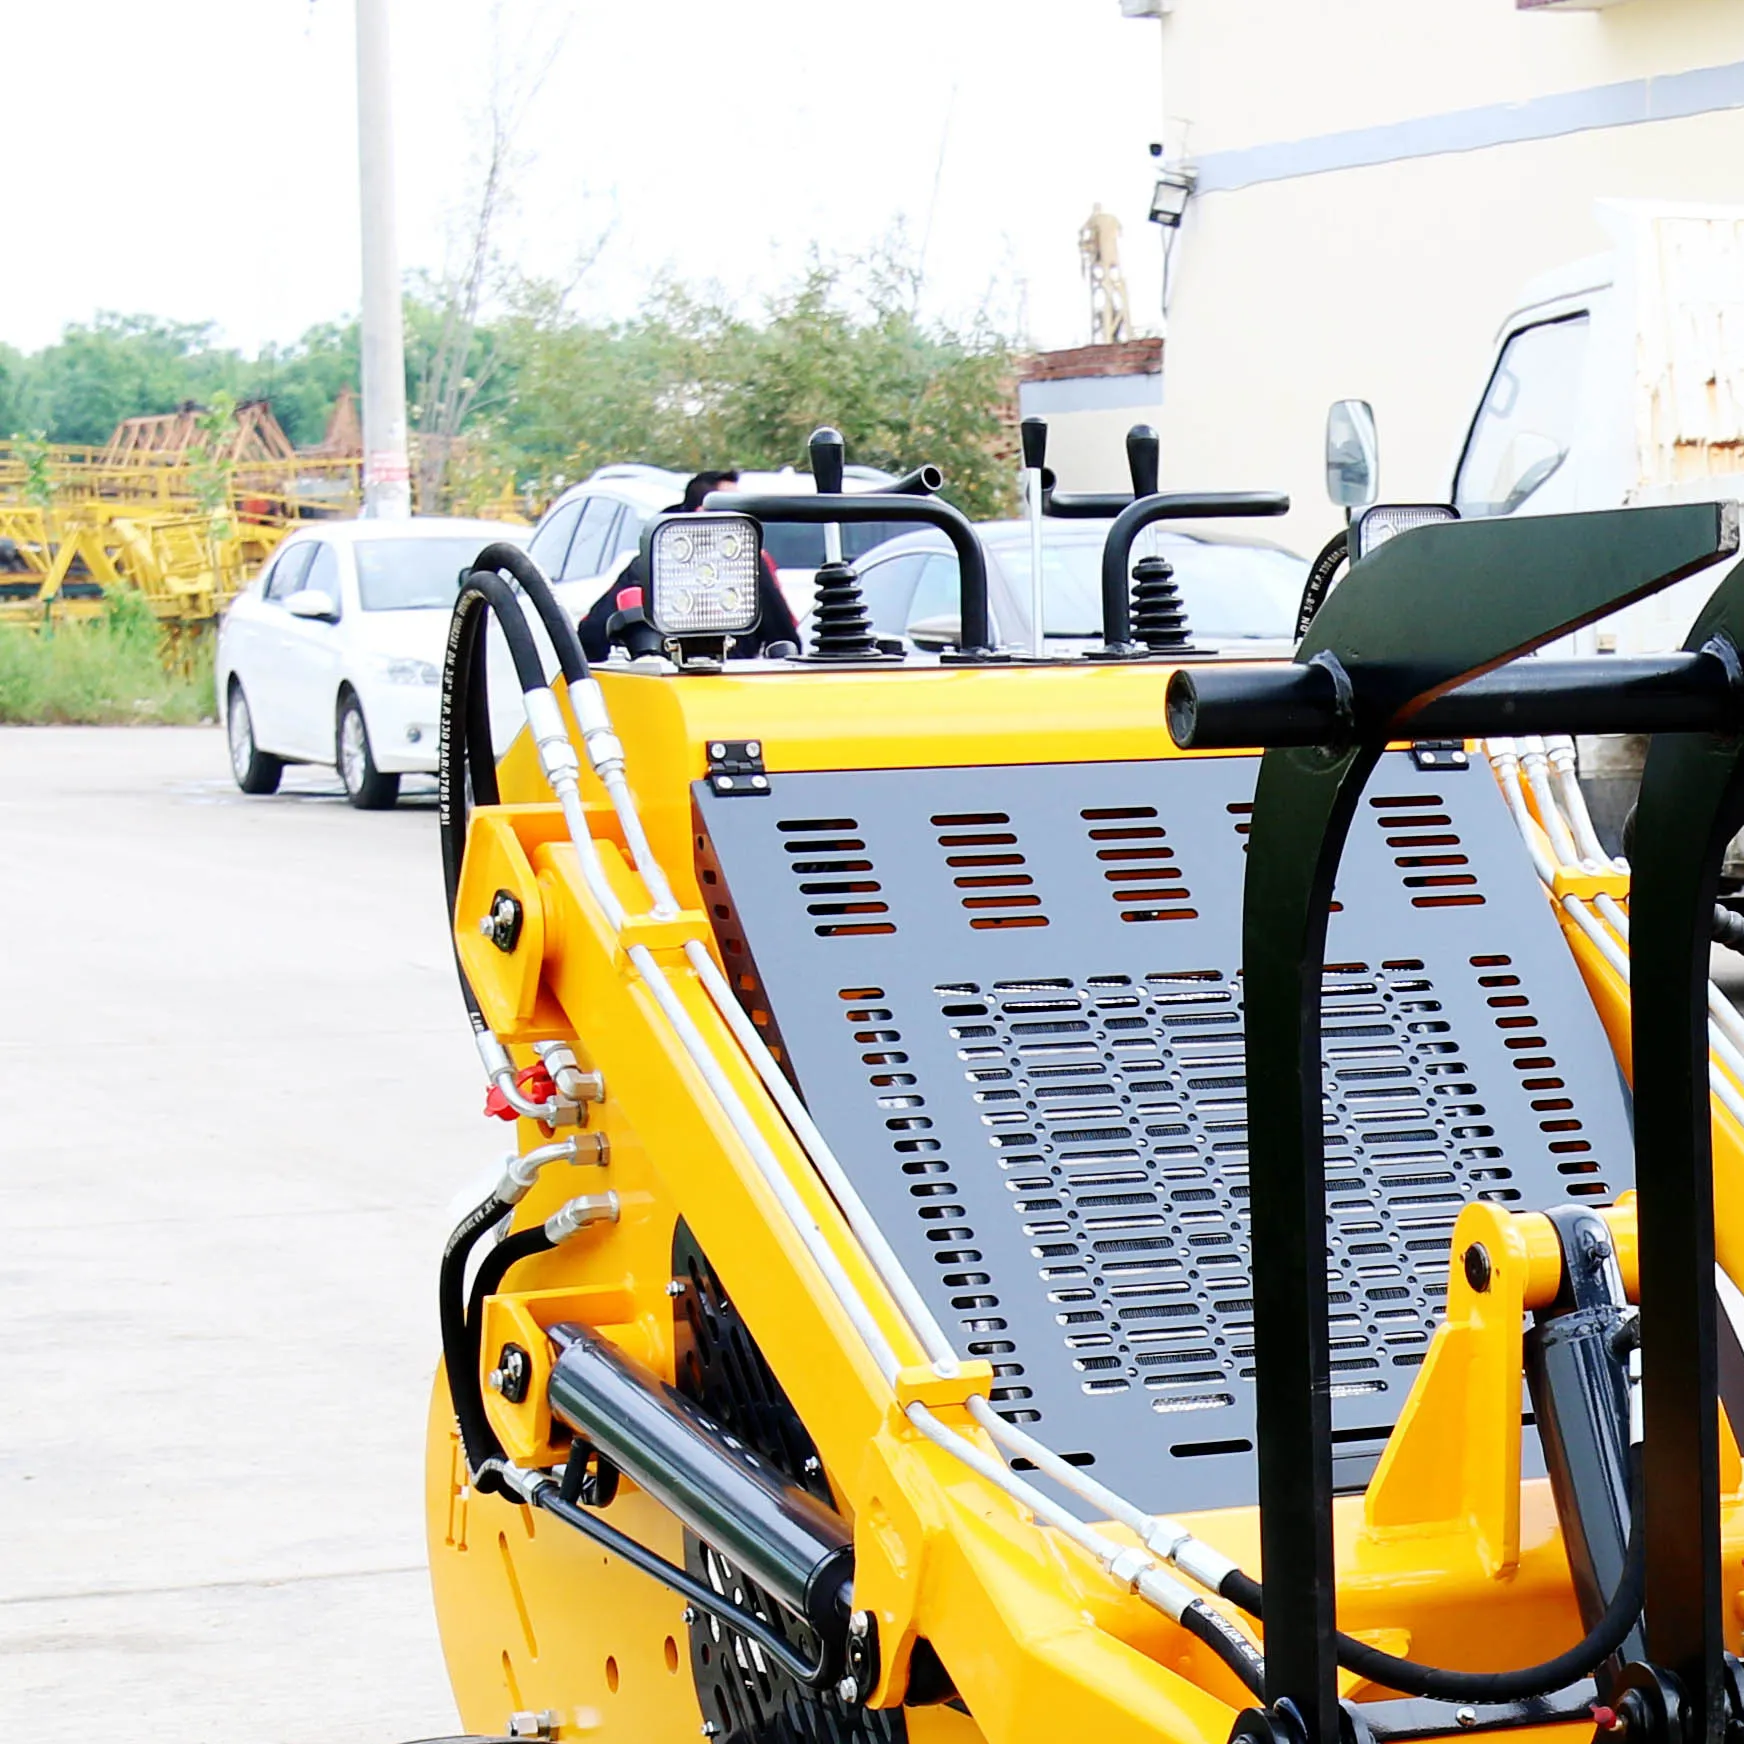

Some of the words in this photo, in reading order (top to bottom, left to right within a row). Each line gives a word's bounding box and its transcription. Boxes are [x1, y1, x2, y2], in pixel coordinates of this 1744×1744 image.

[446, 649, 457, 666] DN
[444, 667, 455, 691] 3/8"
[442, 718, 452, 740] 330
[440, 804, 451, 826] PSI
